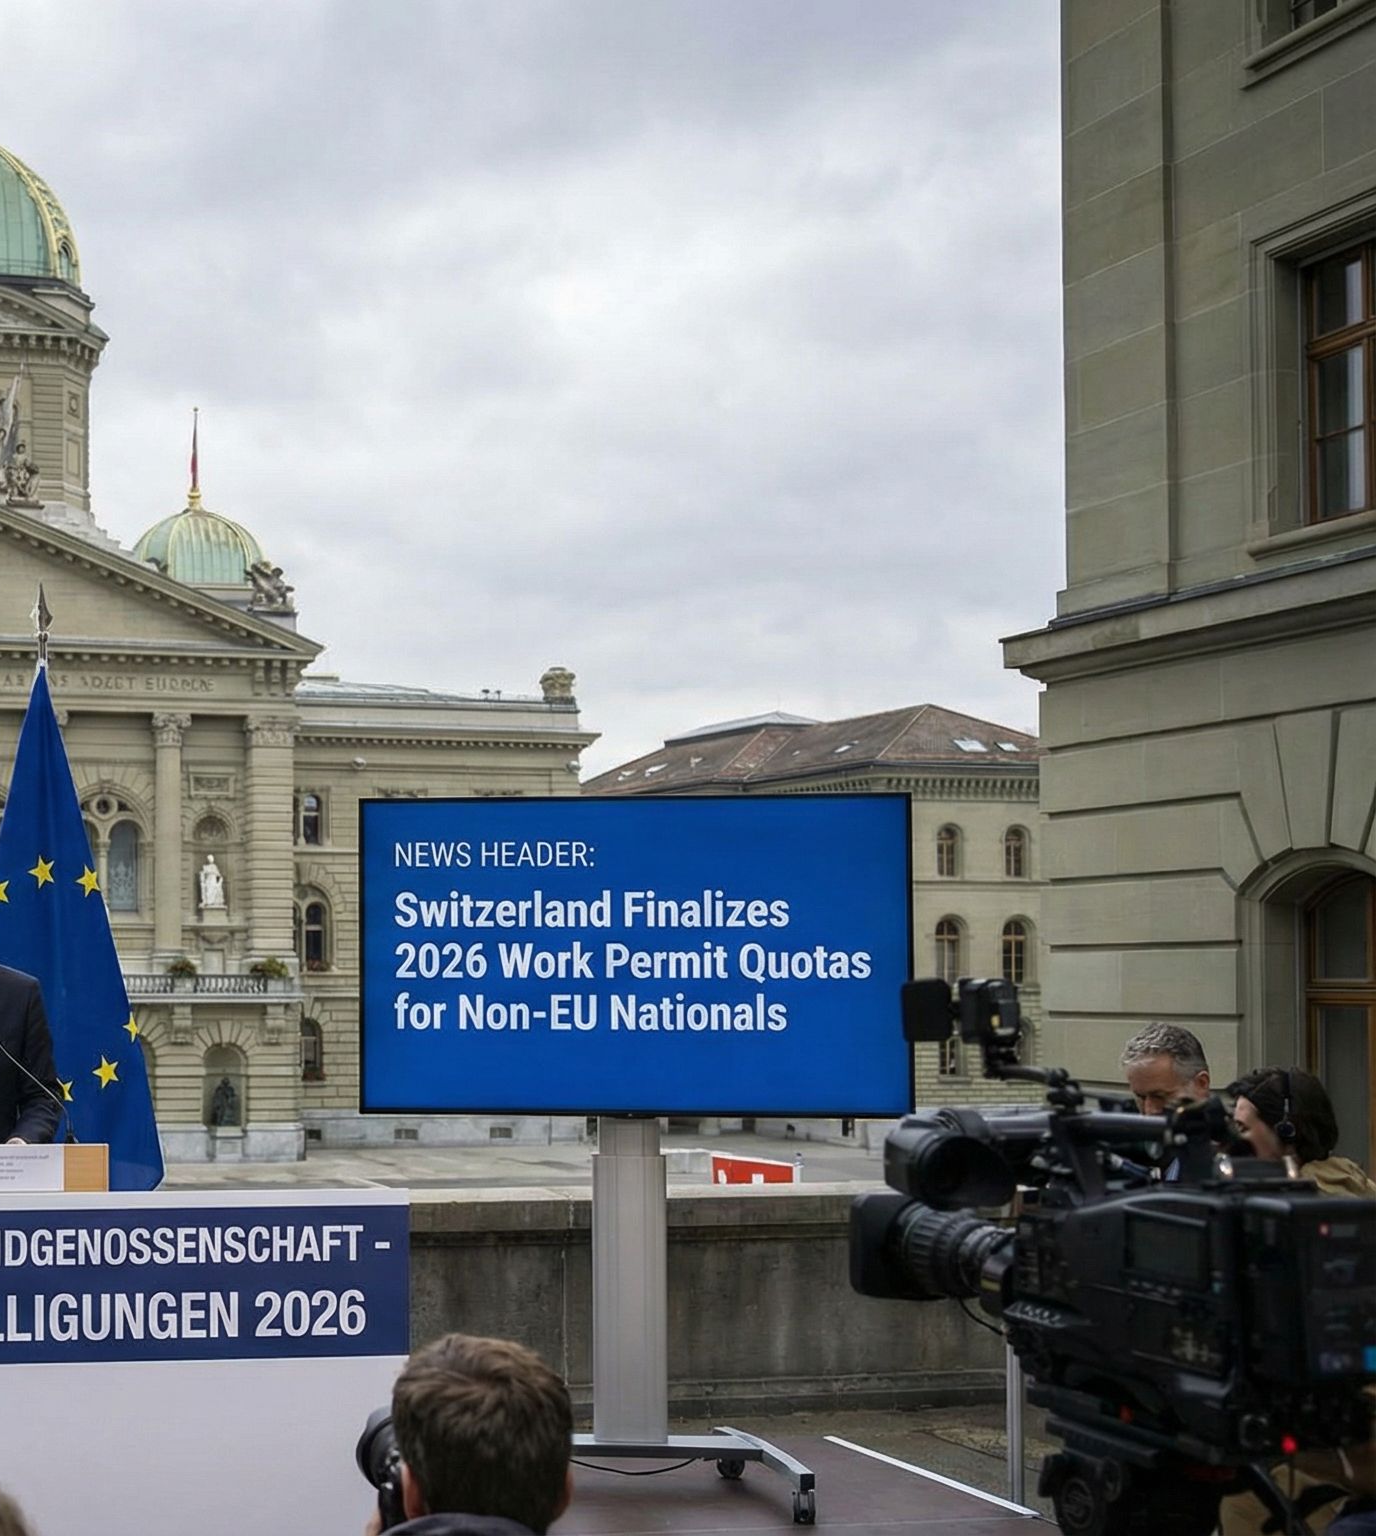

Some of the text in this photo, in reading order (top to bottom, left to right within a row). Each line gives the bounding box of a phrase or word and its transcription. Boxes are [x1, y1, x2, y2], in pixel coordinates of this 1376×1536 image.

[394, 841, 596, 868] NEWS HEADER:
[394, 888, 790, 929] Switzerland Finalizes
[395, 941, 872, 984] 2026 Work Permit Quotas
[394, 991, 788, 1032] for Non-EU Nationals
[254, 1289, 366, 1338] 2026
